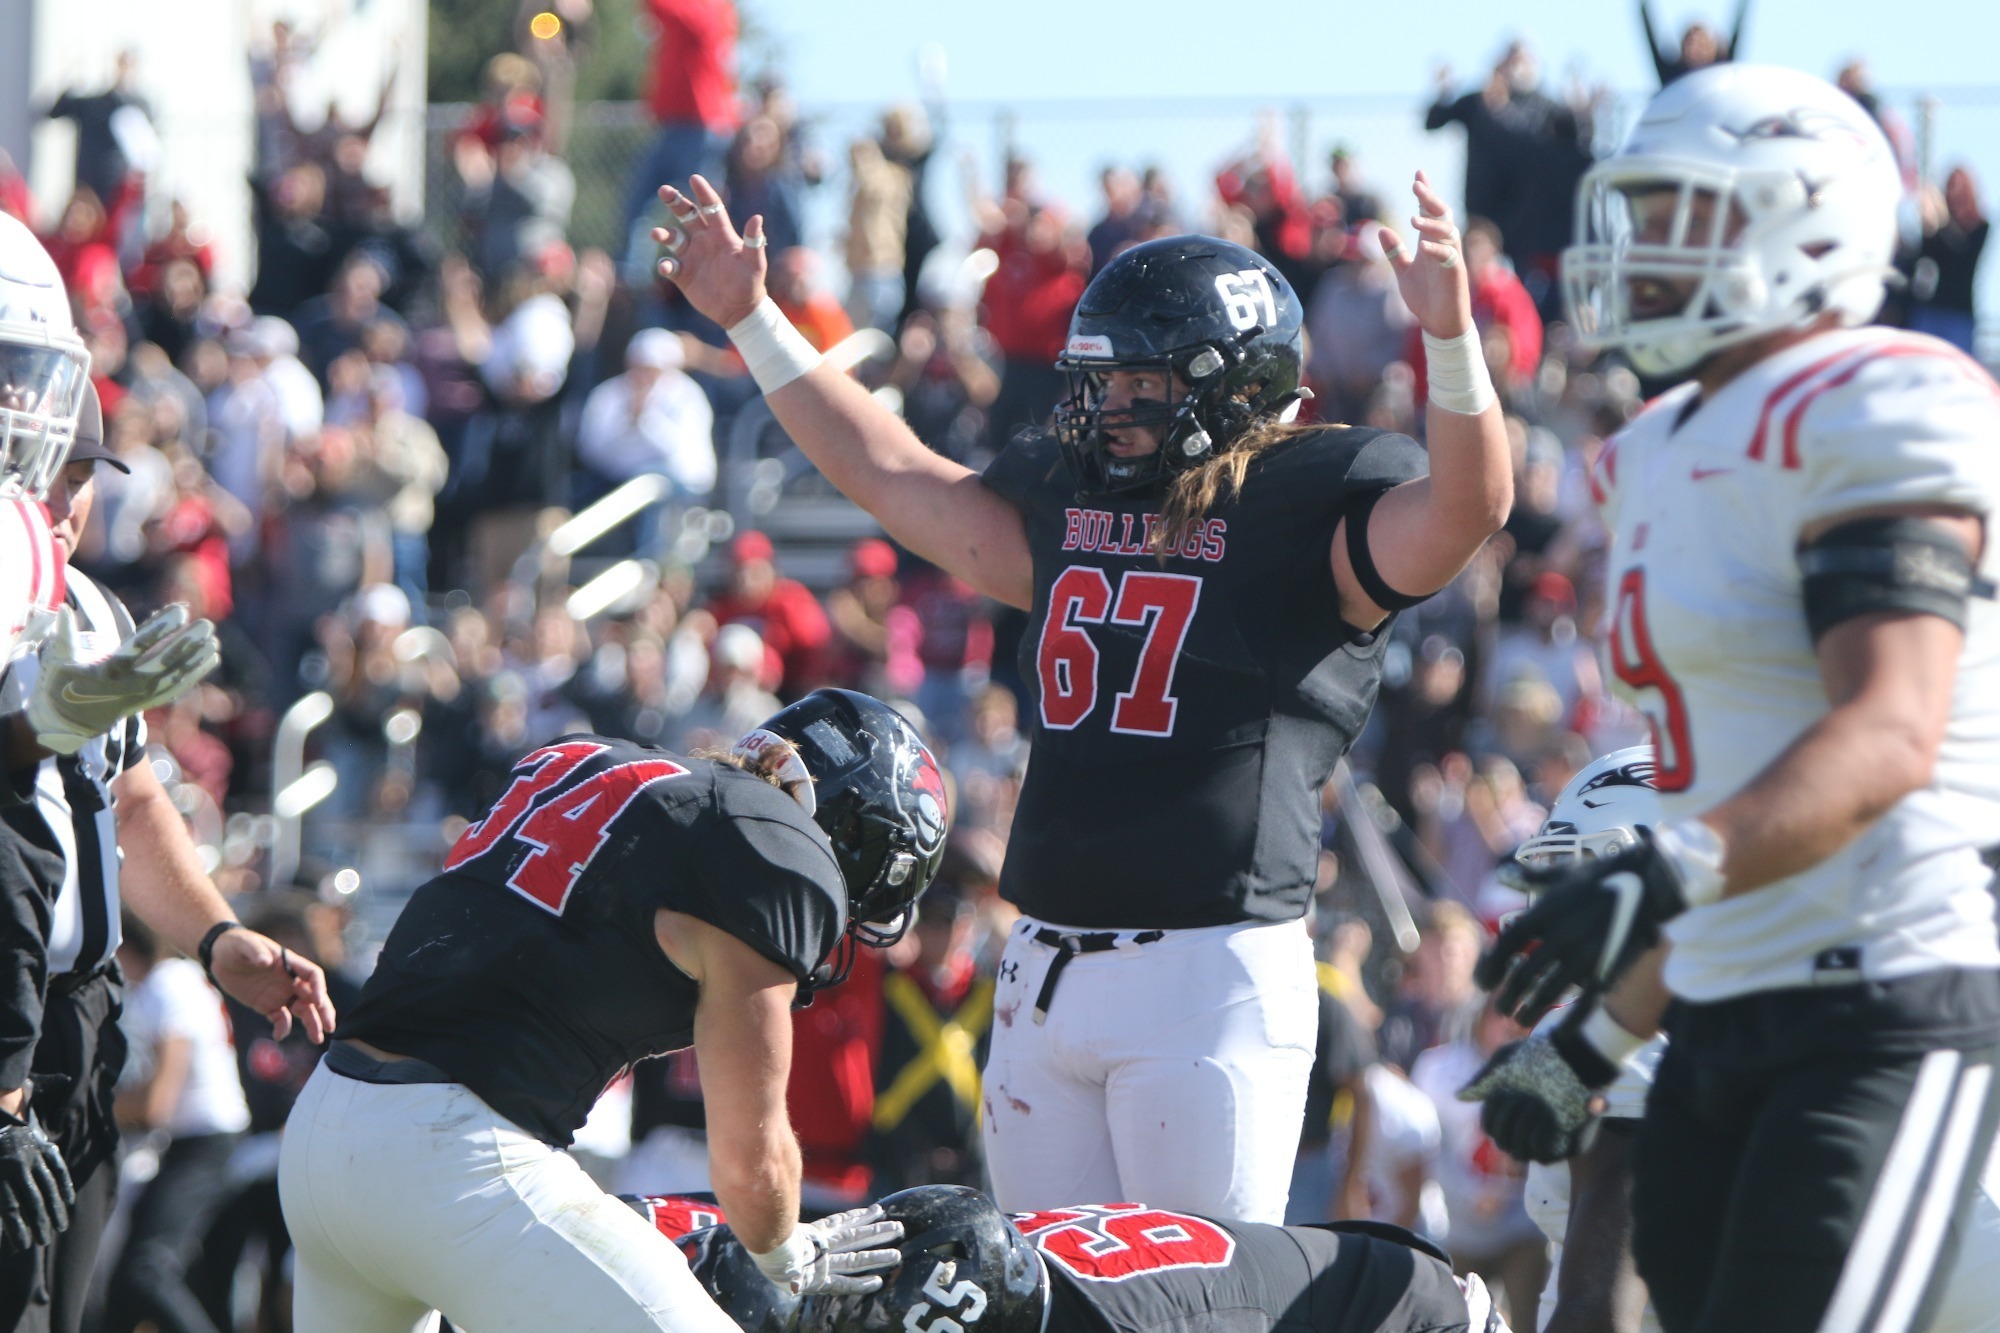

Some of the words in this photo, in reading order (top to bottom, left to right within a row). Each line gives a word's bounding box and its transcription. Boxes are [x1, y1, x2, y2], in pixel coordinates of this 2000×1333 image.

[1214, 269, 1277, 331] 67
[1036, 565, 1203, 738] 67
[442, 741, 691, 917] 34
